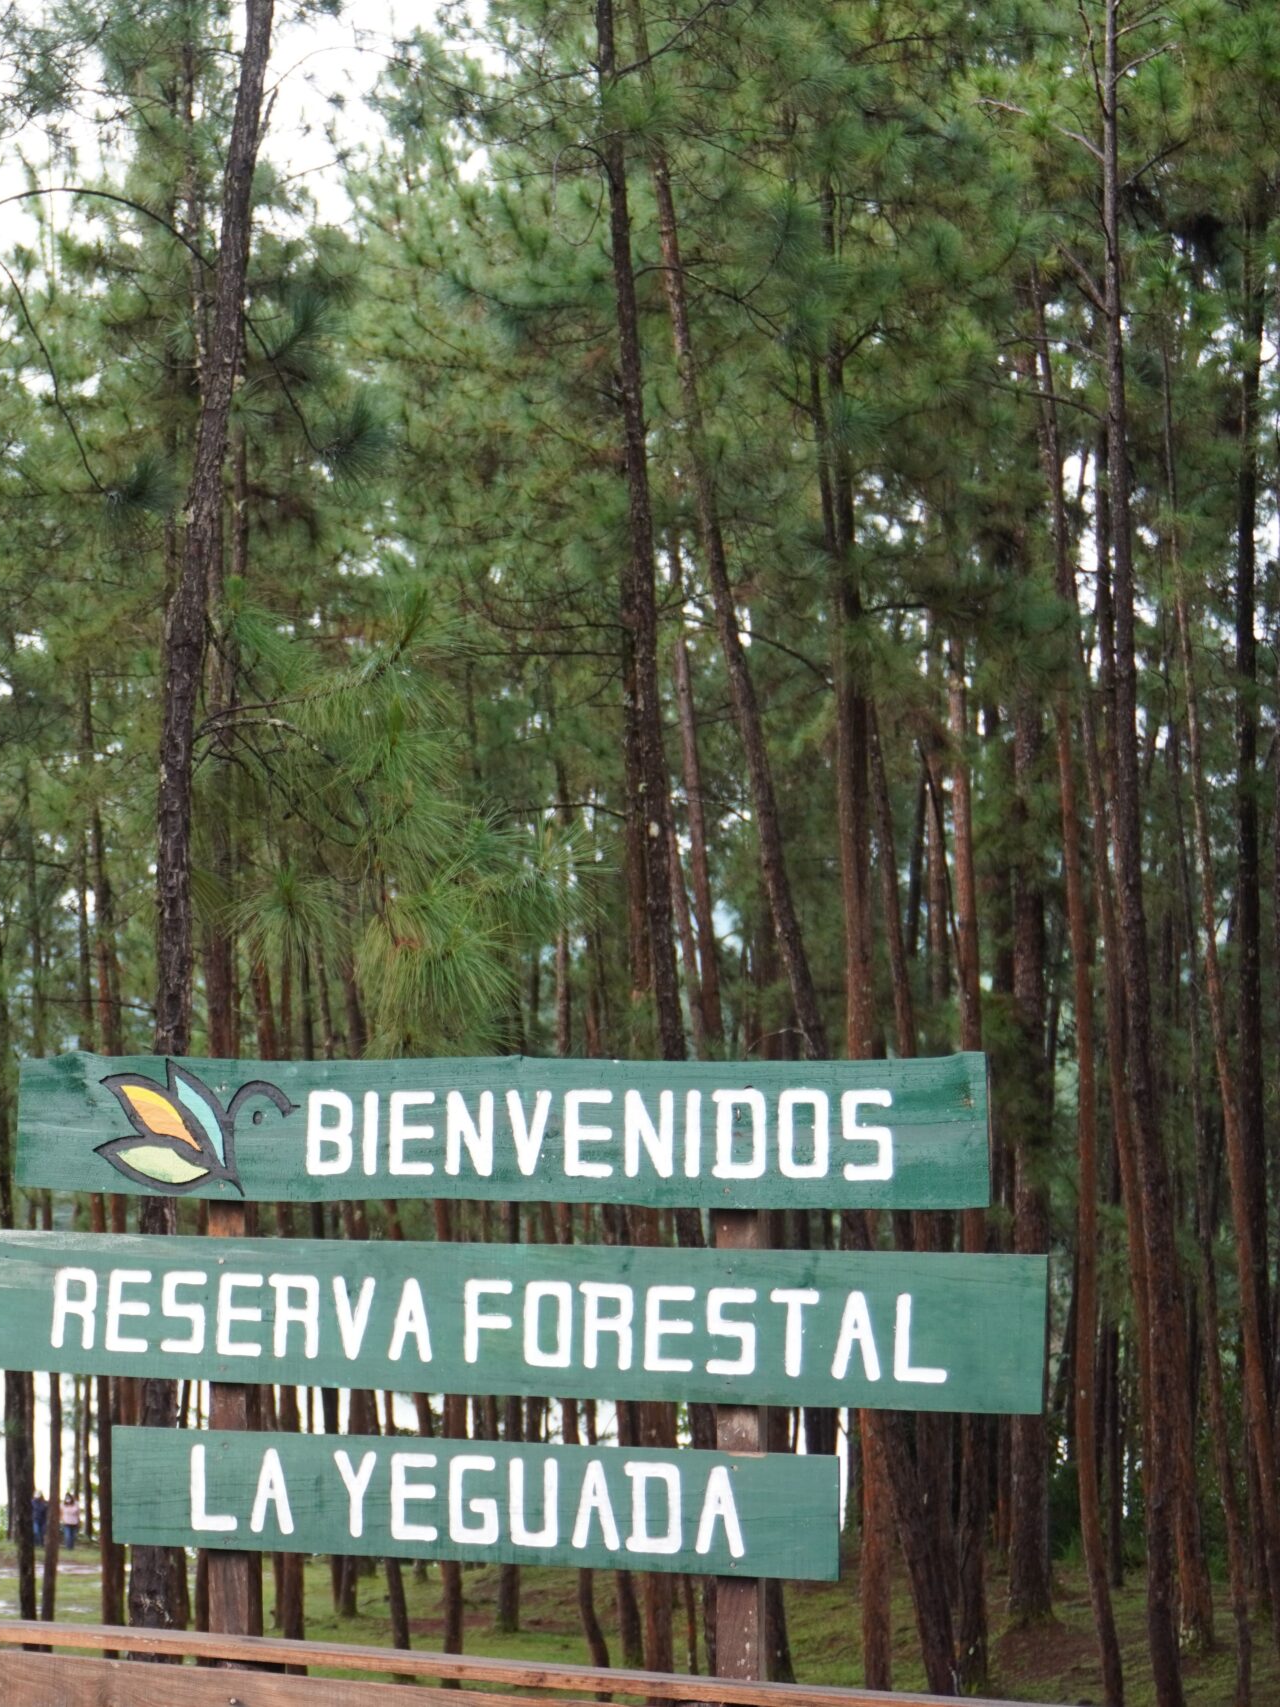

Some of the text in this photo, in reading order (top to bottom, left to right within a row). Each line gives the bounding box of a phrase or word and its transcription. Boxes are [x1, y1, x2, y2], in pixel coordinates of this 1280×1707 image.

[305, 1086, 896, 1184] BIENVENIDOS
[50, 1265, 950, 1386] RESERVA FORESTAL
[189, 1442, 747, 1560] LA YEGUADA
